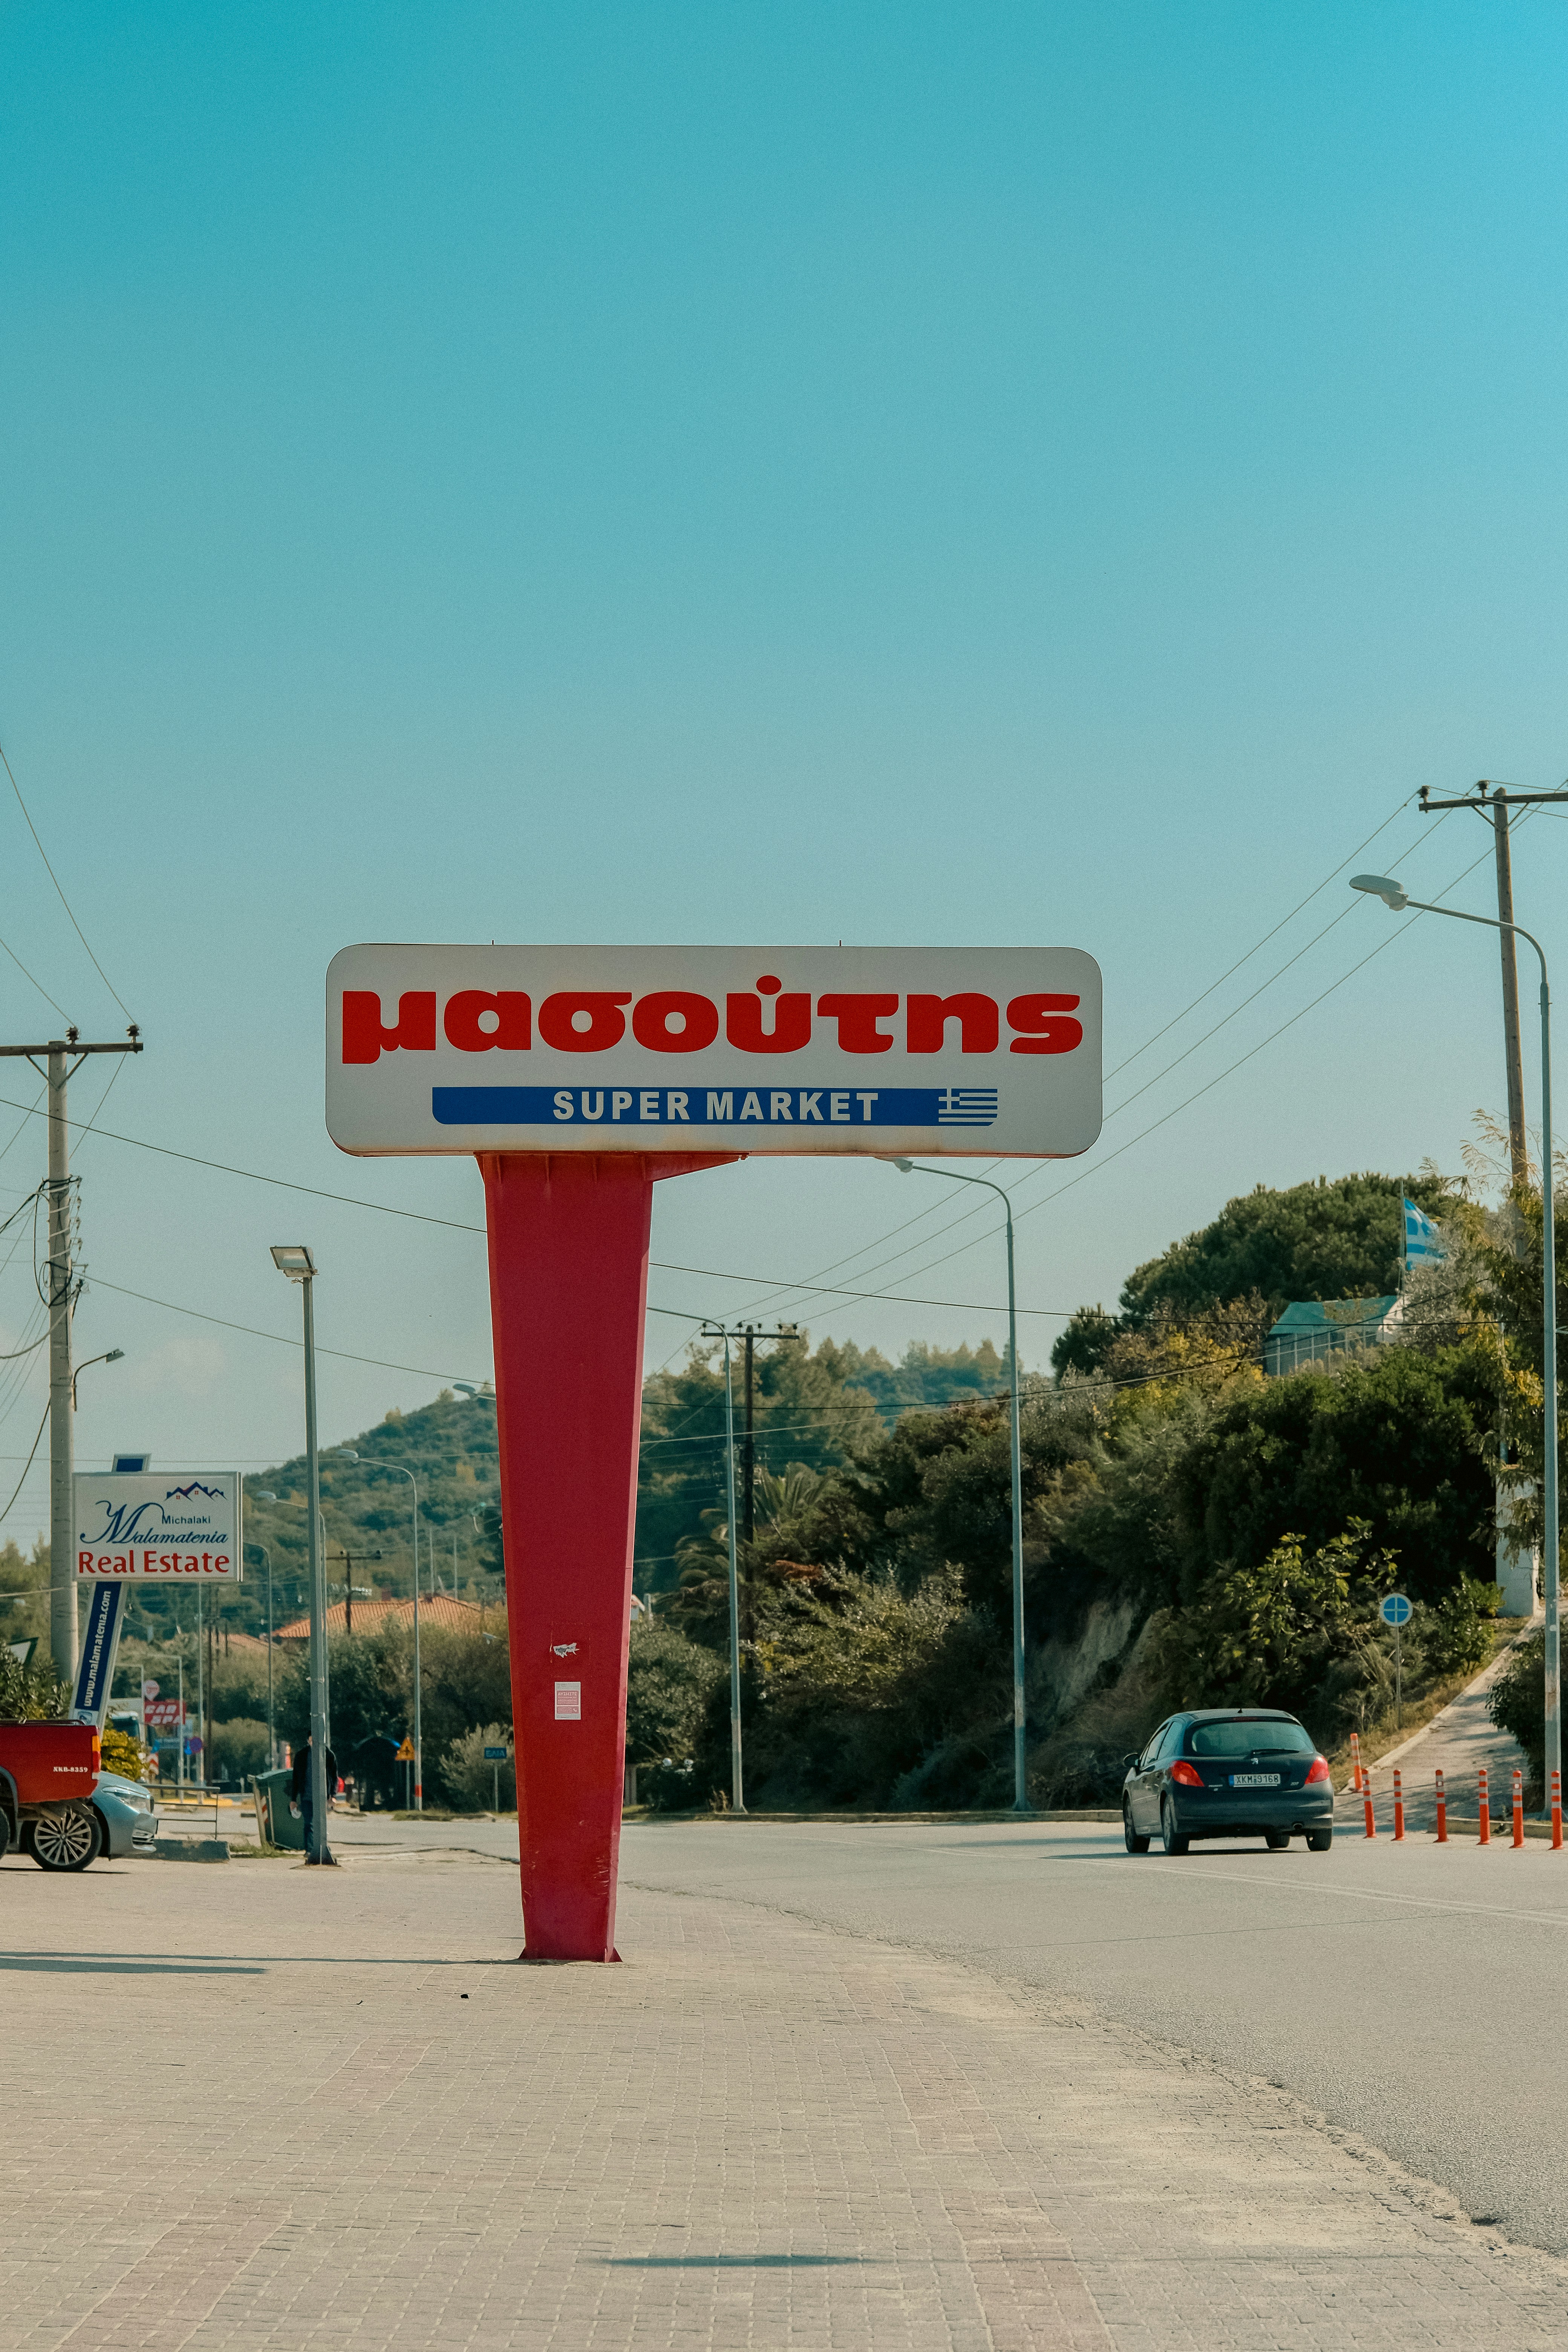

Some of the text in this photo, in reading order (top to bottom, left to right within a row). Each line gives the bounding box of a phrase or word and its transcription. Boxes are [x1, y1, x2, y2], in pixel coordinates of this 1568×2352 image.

[553, 1091, 881, 1121] SUPER MARKET
[80, 1501, 228, 1544] Malamatenia
[162, 1515, 210, 1524] Michalaki
[78, 1550, 229, 1573] Real Estate
[84, 1591, 112, 1707] www.malamatenia.com
